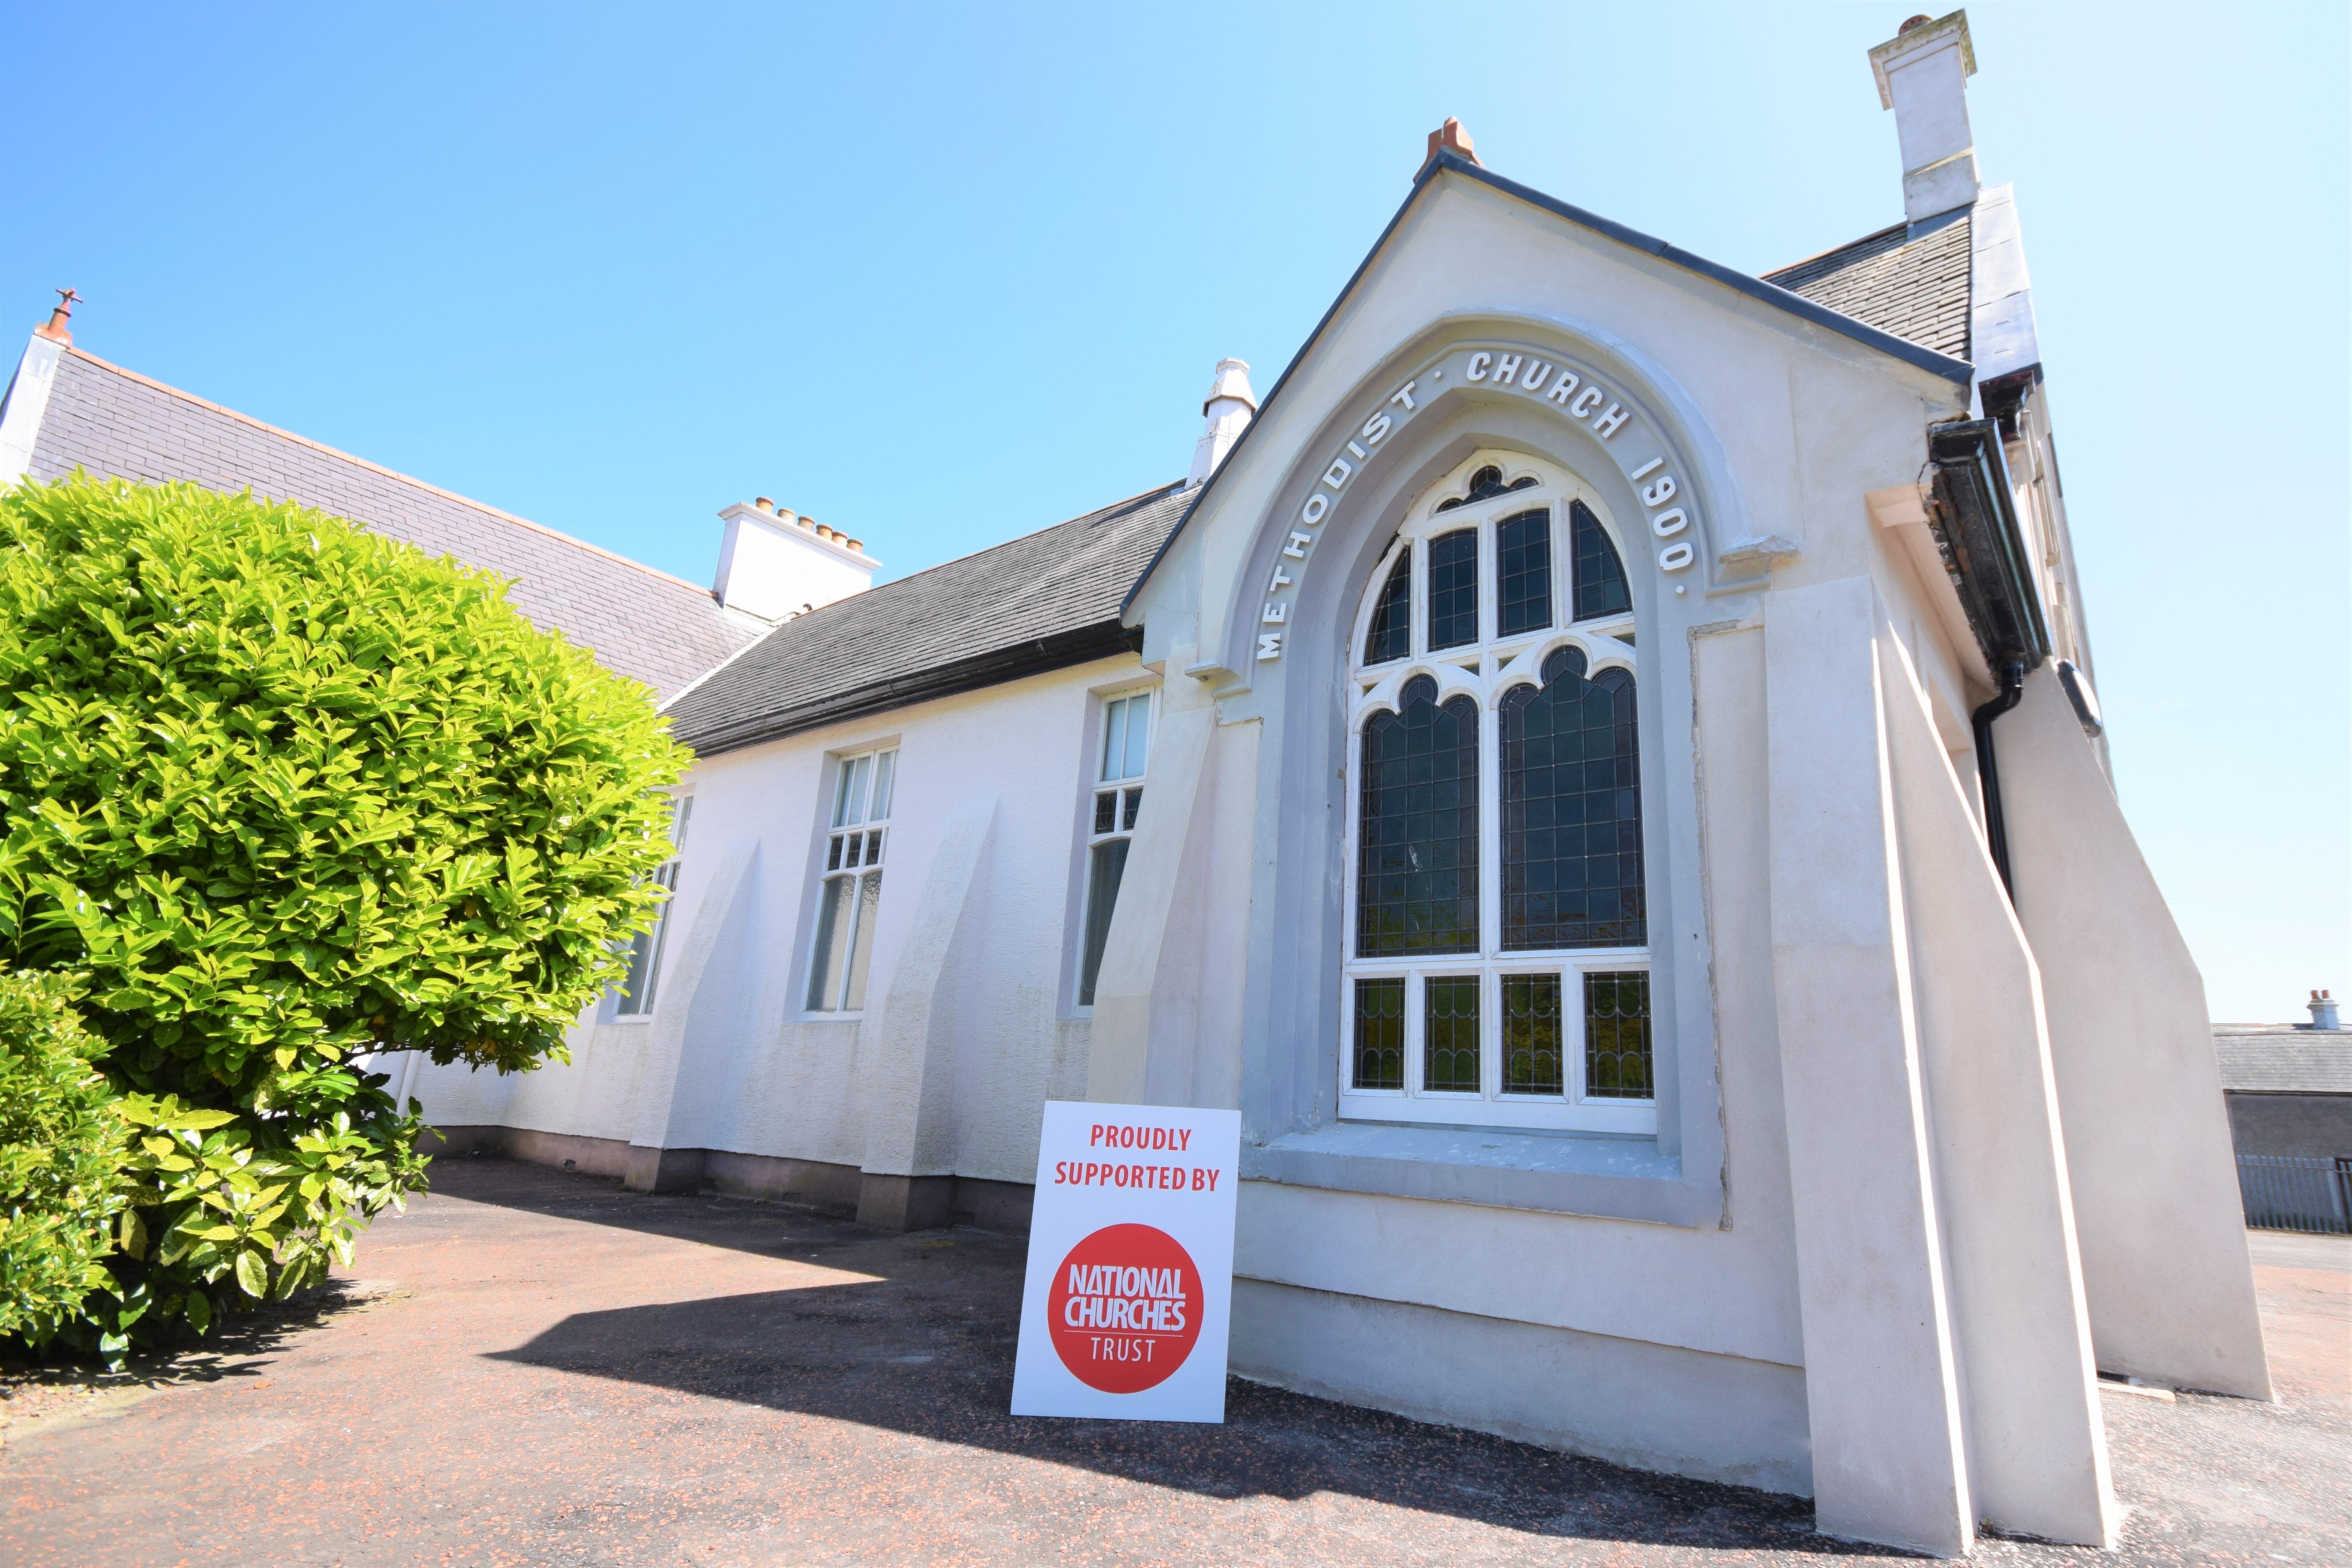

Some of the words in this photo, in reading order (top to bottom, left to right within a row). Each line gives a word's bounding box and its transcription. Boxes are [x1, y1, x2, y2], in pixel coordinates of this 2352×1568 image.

[1257, 381, 1417, 661] METHODIST
[1467, 352, 1629, 439] CHURCH
[1632, 456, 1694, 571] 1900
[1090, 1124, 1191, 1151] PROUDLY
[1055, 1162, 1186, 1190] SUPPORTED
[1192, 1169, 1220, 1192] BY
[1068, 1265, 1185, 1299] NATIONAL
[1065, 1297, 1185, 1331] CHURCHES
[1091, 1337, 1155, 1362] TRUST
